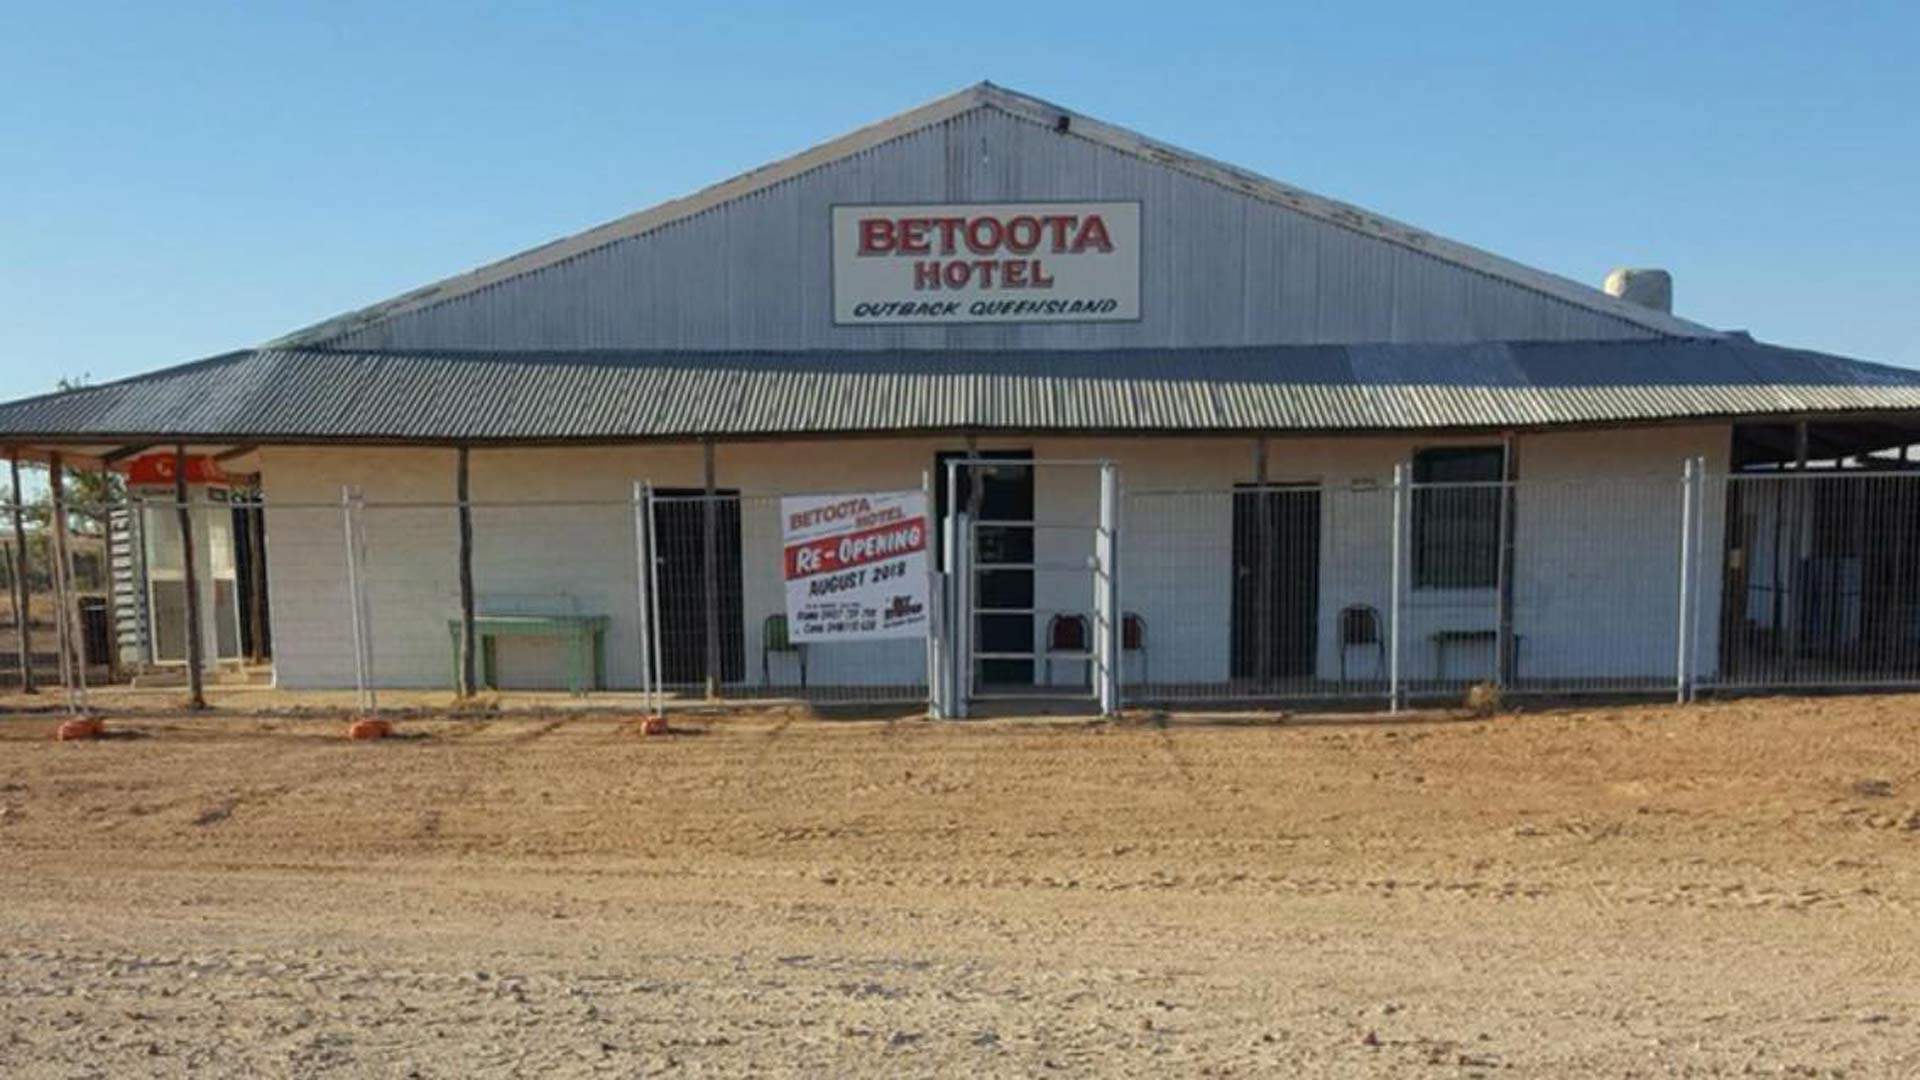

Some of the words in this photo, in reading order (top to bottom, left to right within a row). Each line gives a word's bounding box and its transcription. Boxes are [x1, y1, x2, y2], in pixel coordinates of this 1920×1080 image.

[857, 214, 1114, 257] BETOOTA
[914, 260, 1054, 291] HOTEL
[853, 301, 960, 318] OUTBACK
[969, 299, 1118, 317] QUEENSLAND
[855, 507, 904, 527] HOTEL
[809, 570, 866, 597] AUGUST
[872, 561, 906, 582] 2018
